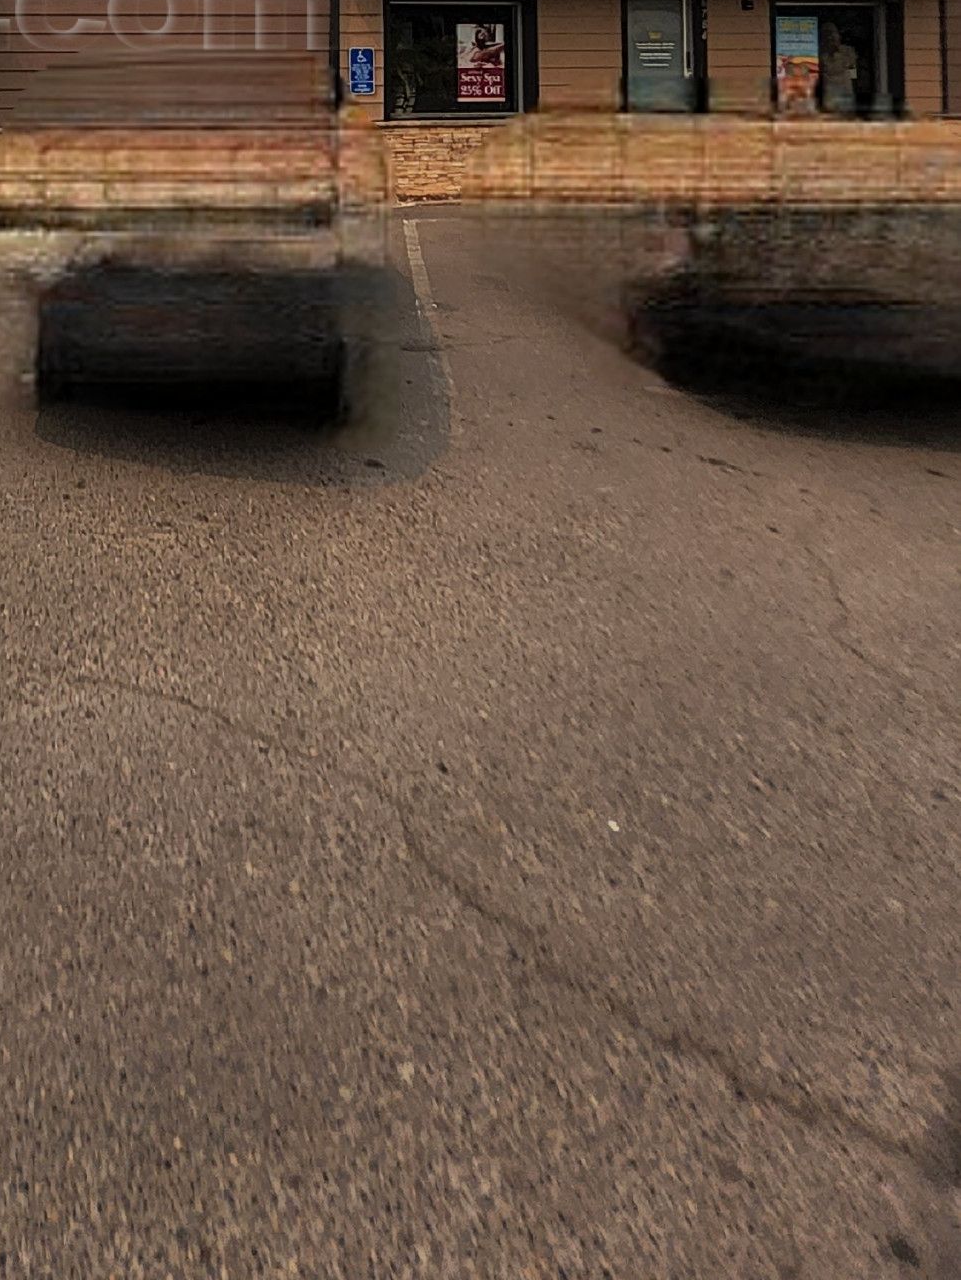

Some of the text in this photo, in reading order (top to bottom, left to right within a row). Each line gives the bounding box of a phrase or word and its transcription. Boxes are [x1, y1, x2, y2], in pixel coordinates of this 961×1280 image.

[460, 73, 501, 86] Sexy Spa
[460, 85, 502, 96] 25% Off
